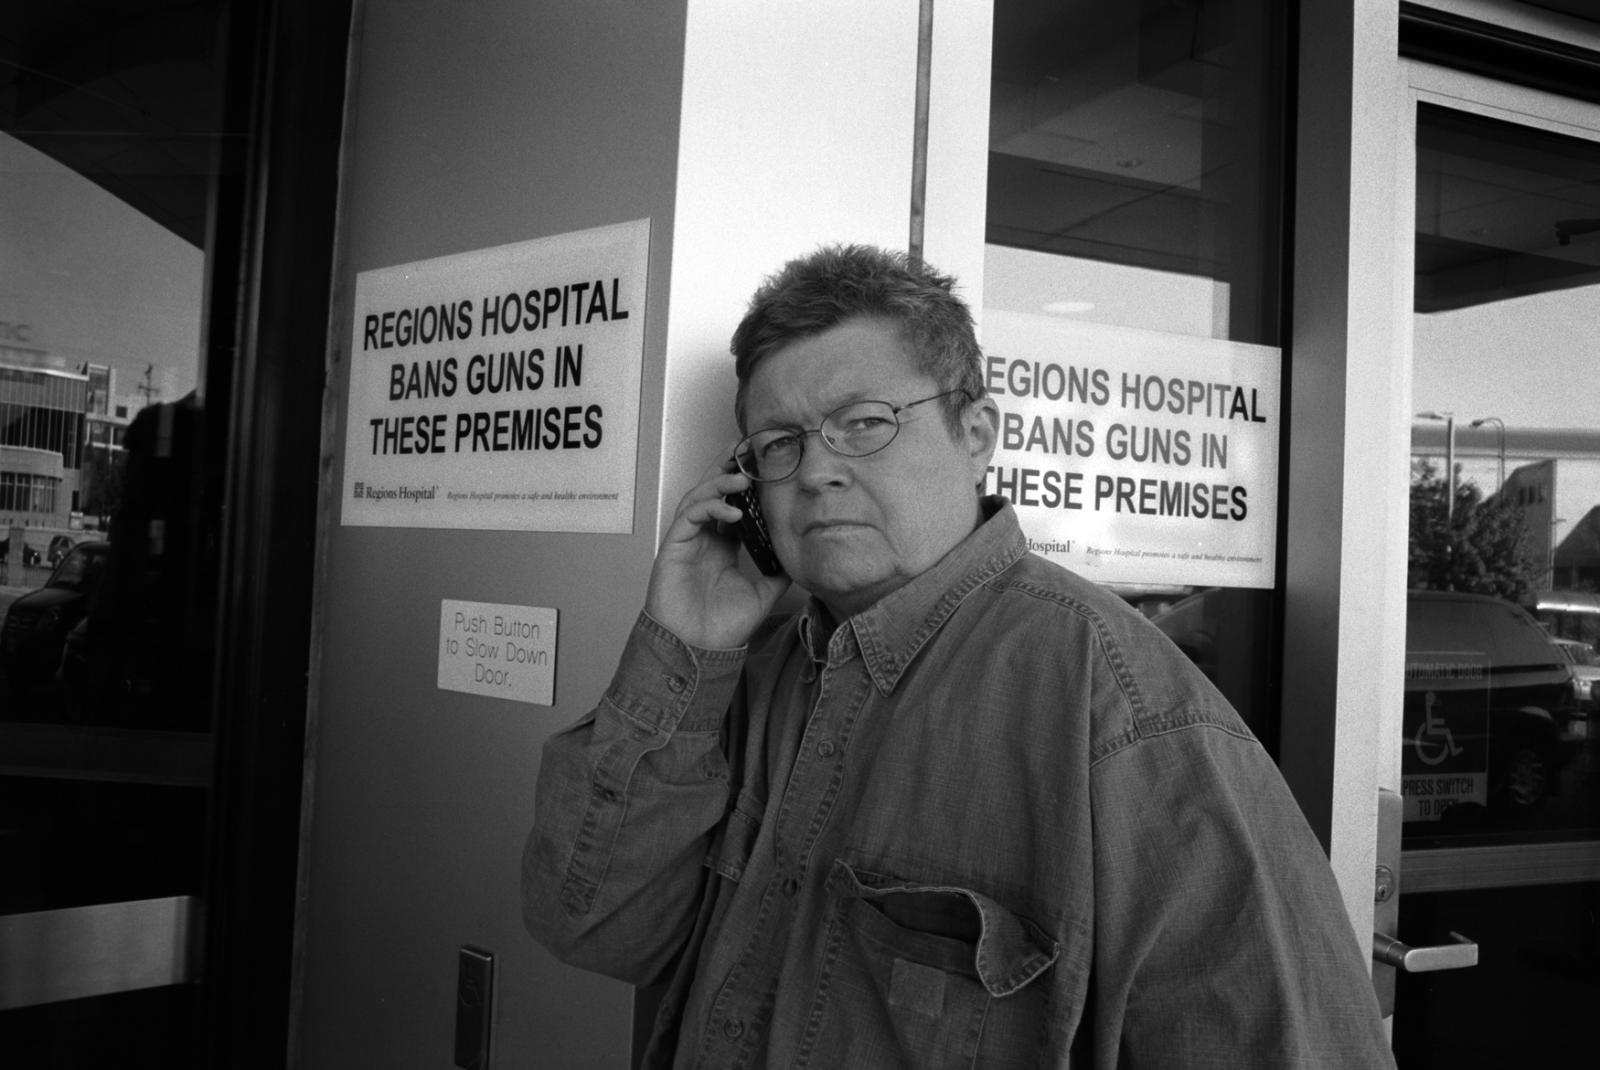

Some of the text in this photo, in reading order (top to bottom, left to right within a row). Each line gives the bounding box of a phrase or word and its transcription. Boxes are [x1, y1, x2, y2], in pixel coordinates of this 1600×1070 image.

[364, 278, 629, 351] REGIONS HOSPITAL
[389, 344, 583, 401] BANS GUNS IN
[986, 356, 1267, 423] EGIONS HOSPITAL
[370, 404, 603, 455] THESE PREMISES
[1002, 412, 1228, 469] BANS GUNS IN
[366, 484, 435, 503] Regions Hospital
[469, 491, 494, 502] Hospital
[1095, 474, 1248, 521] PREMISES
[455, 611, 540, 640] Push Button
[446, 637, 547, 666] to Slow Down
[475, 663, 512, 687] Door.
[1402, 776, 1474, 796] PRESS SWITCH
[1418, 799, 1431, 816] TO
